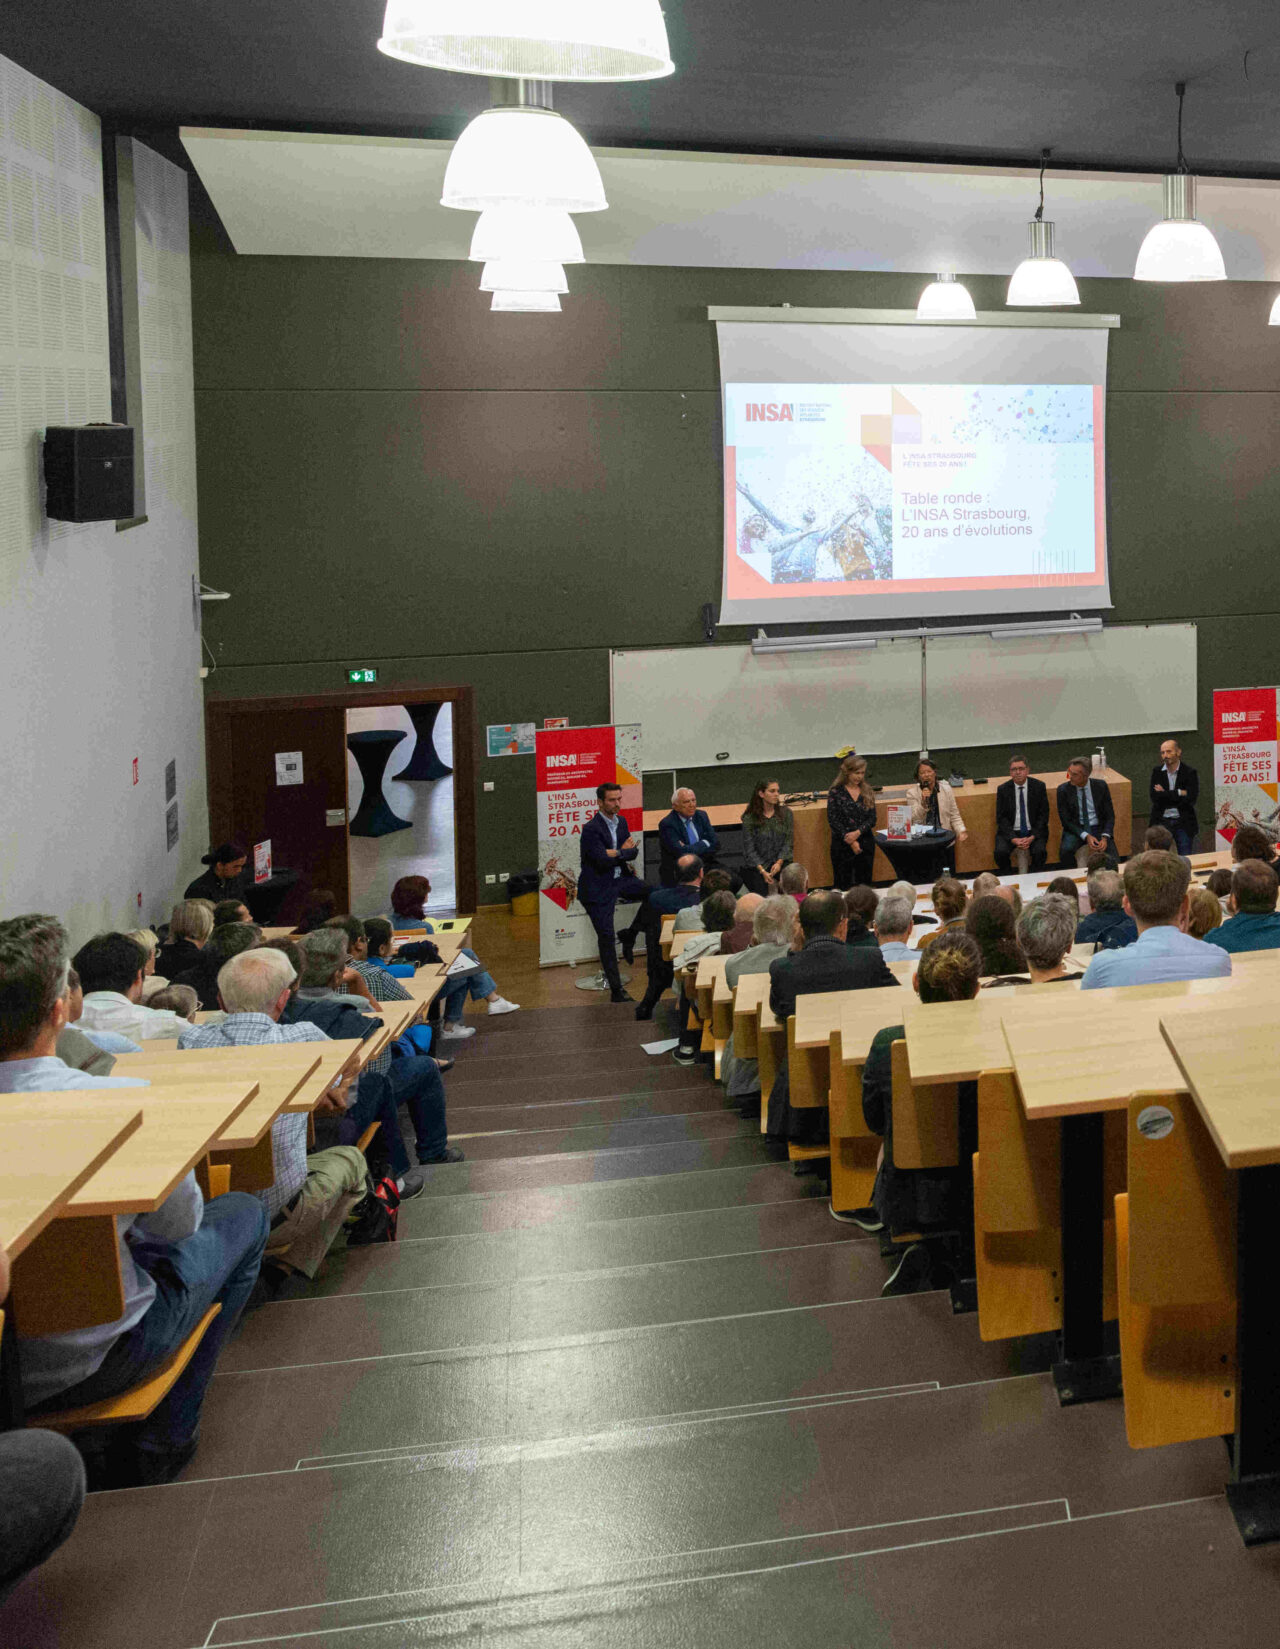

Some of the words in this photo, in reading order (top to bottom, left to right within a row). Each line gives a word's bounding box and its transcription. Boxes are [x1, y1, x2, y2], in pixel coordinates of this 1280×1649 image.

[745, 402, 794, 422] INSA
[901, 491, 939, 505] Table
[943, 491, 982, 505] ronde
[901, 508, 950, 522] L'INSA
[952, 507, 1031, 522] Strasbourg,
[901, 525, 919, 539] 20
[923, 526, 949, 538] ans
[952, 523, 1033, 538] d'évolutions
[1222, 711, 1246, 723] INSA
[1222, 745, 1246, 753] L'INSA
[1223, 751, 1271, 760] STRASBOURG
[546, 753, 577, 768] INSA
[1223, 760, 1249, 773] FÊTE
[1251, 760, 1272, 771] SES
[1223, 774, 1238, 784] 20
[547, 791, 578, 802] L'INSA
[547, 799, 600, 811] STRASBOU
[548, 809, 580, 825] FÊTE
[548, 825, 567, 838] 20
